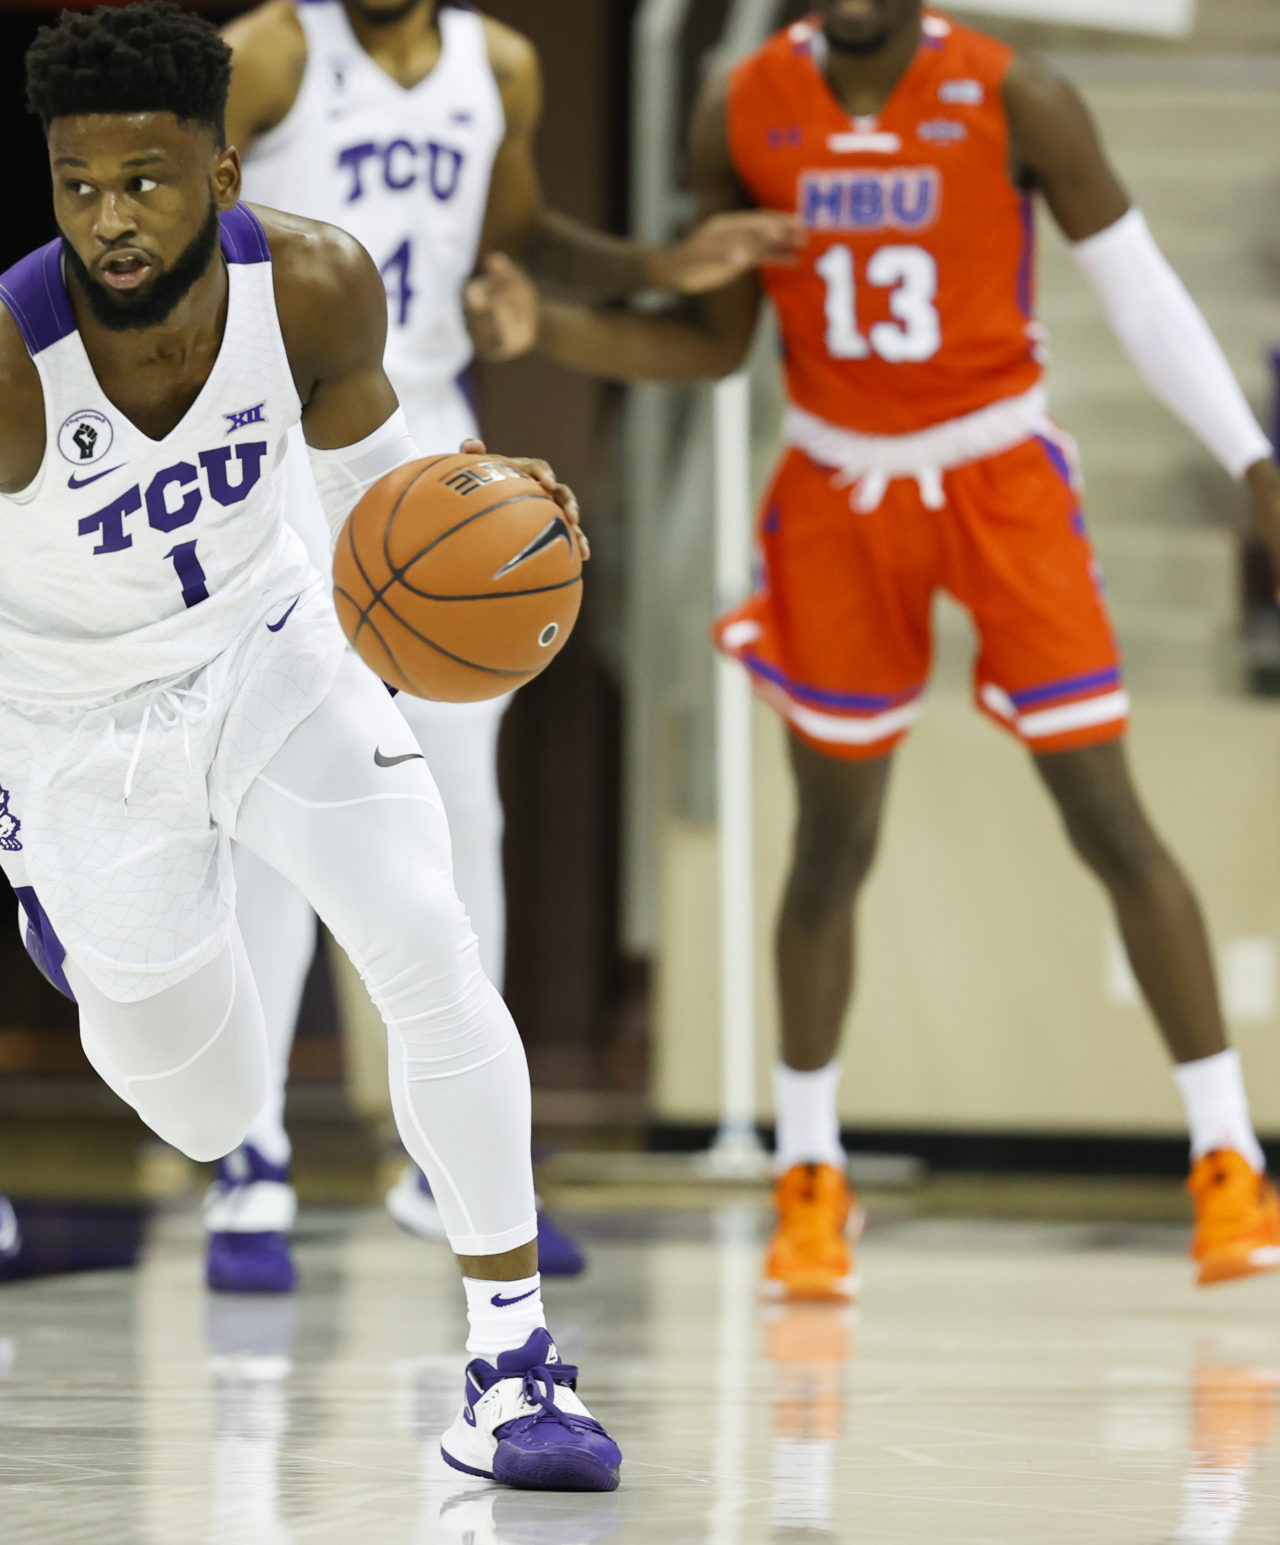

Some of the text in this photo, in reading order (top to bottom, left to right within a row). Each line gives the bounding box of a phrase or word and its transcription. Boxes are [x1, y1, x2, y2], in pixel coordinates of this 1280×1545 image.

[337, 139, 464, 202] TCU
[799, 166, 941, 232] HBU
[380, 240, 414, 325] 4
[815, 244, 941, 362] 13
[78, 441, 267, 555] TCU
[163, 539, 210, 608] 1
